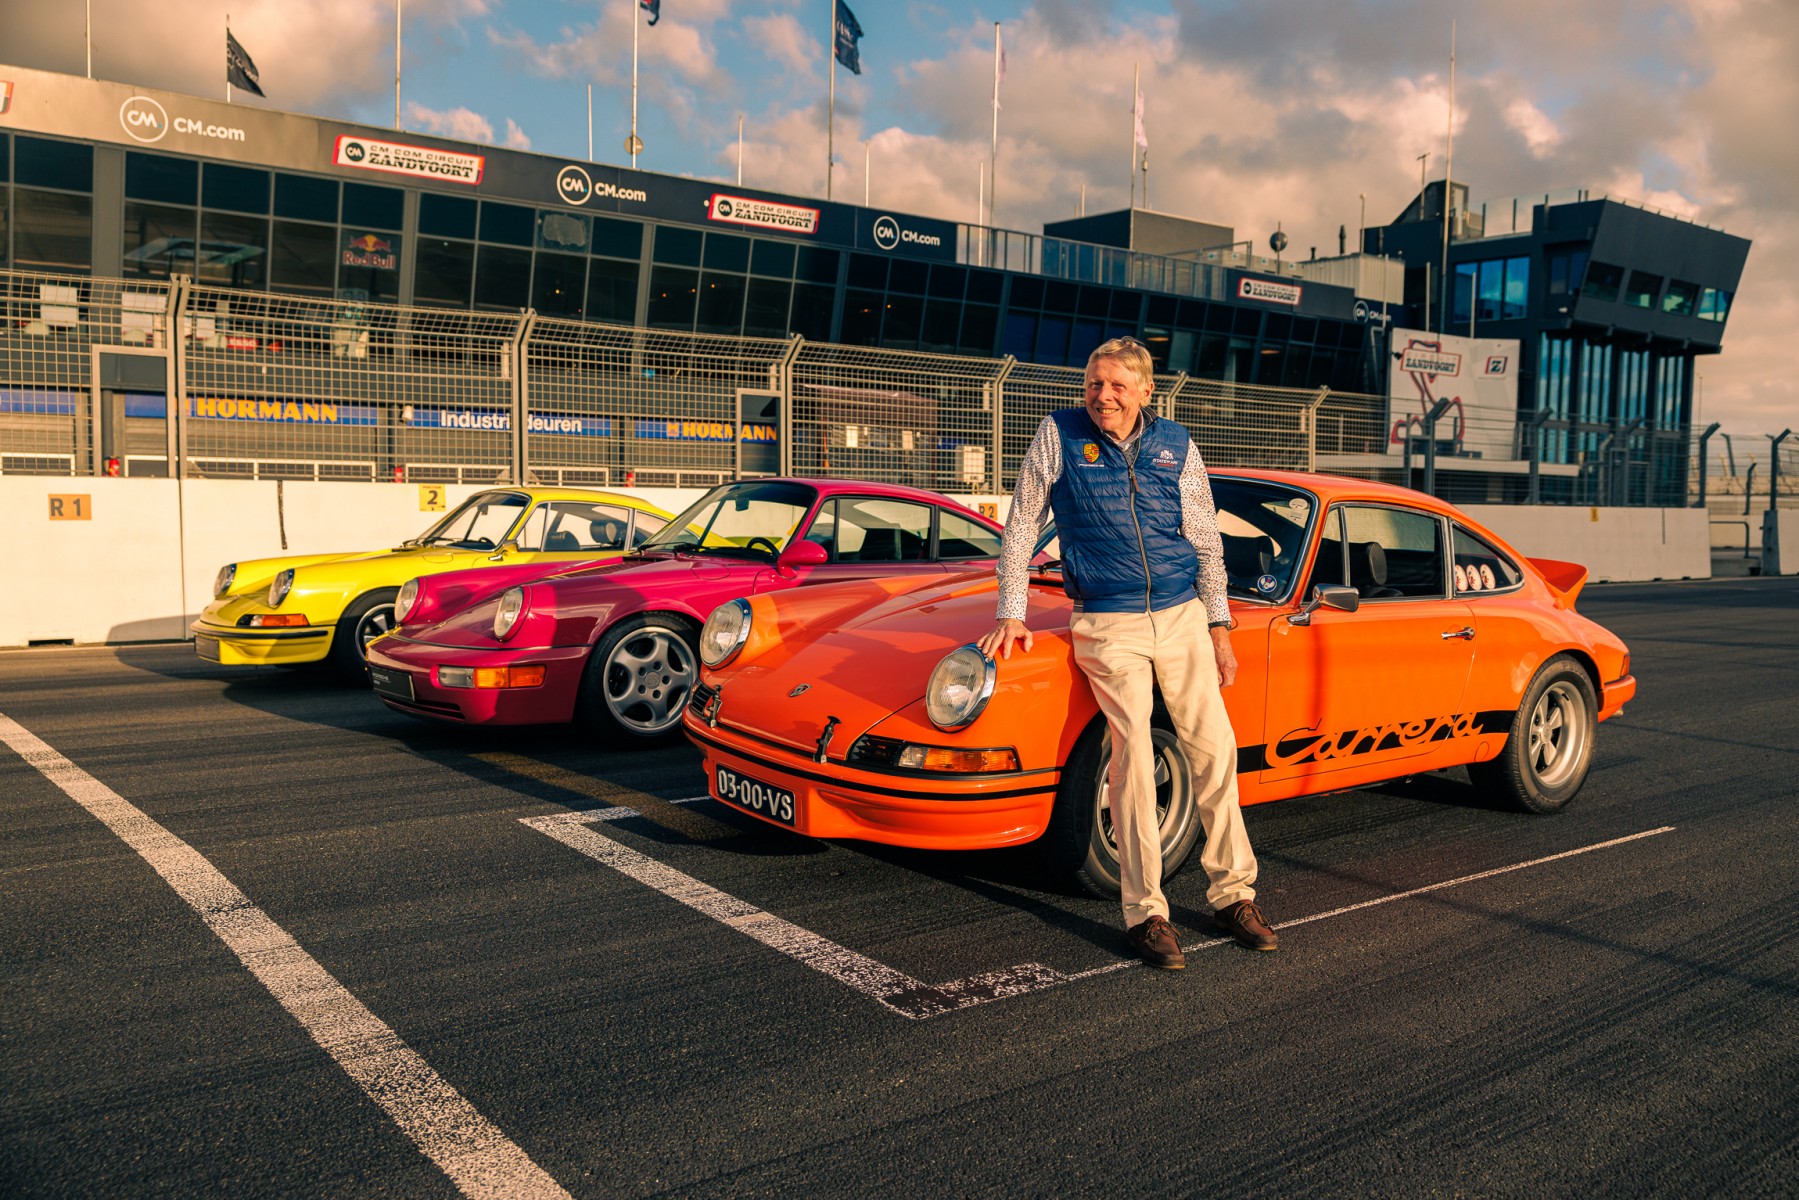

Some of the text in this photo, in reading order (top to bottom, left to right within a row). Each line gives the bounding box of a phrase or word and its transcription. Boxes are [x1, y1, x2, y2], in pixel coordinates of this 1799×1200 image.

[173, 117, 245, 142] CM.com
[368, 153, 473, 178] ZANDVOORT
[370, 145, 475, 166] CM.COM CIRCUIT
[594, 182, 647, 202] CM.com
[734, 208, 812, 229] ZANDVOORT
[777, 207, 813, 218] CIRCUIT
[901, 230, 941, 246] CM.com
[342, 250, 396, 270] Red Bull
[1405, 357, 1456, 373] ZANDVOORT
[1490, 360, 1502, 373] Z
[50, 497, 81, 517] R 1
[427, 489, 438, 505] 2
[988, 505, 995, 518] 2
[1265, 712, 1485, 768] Carrera
